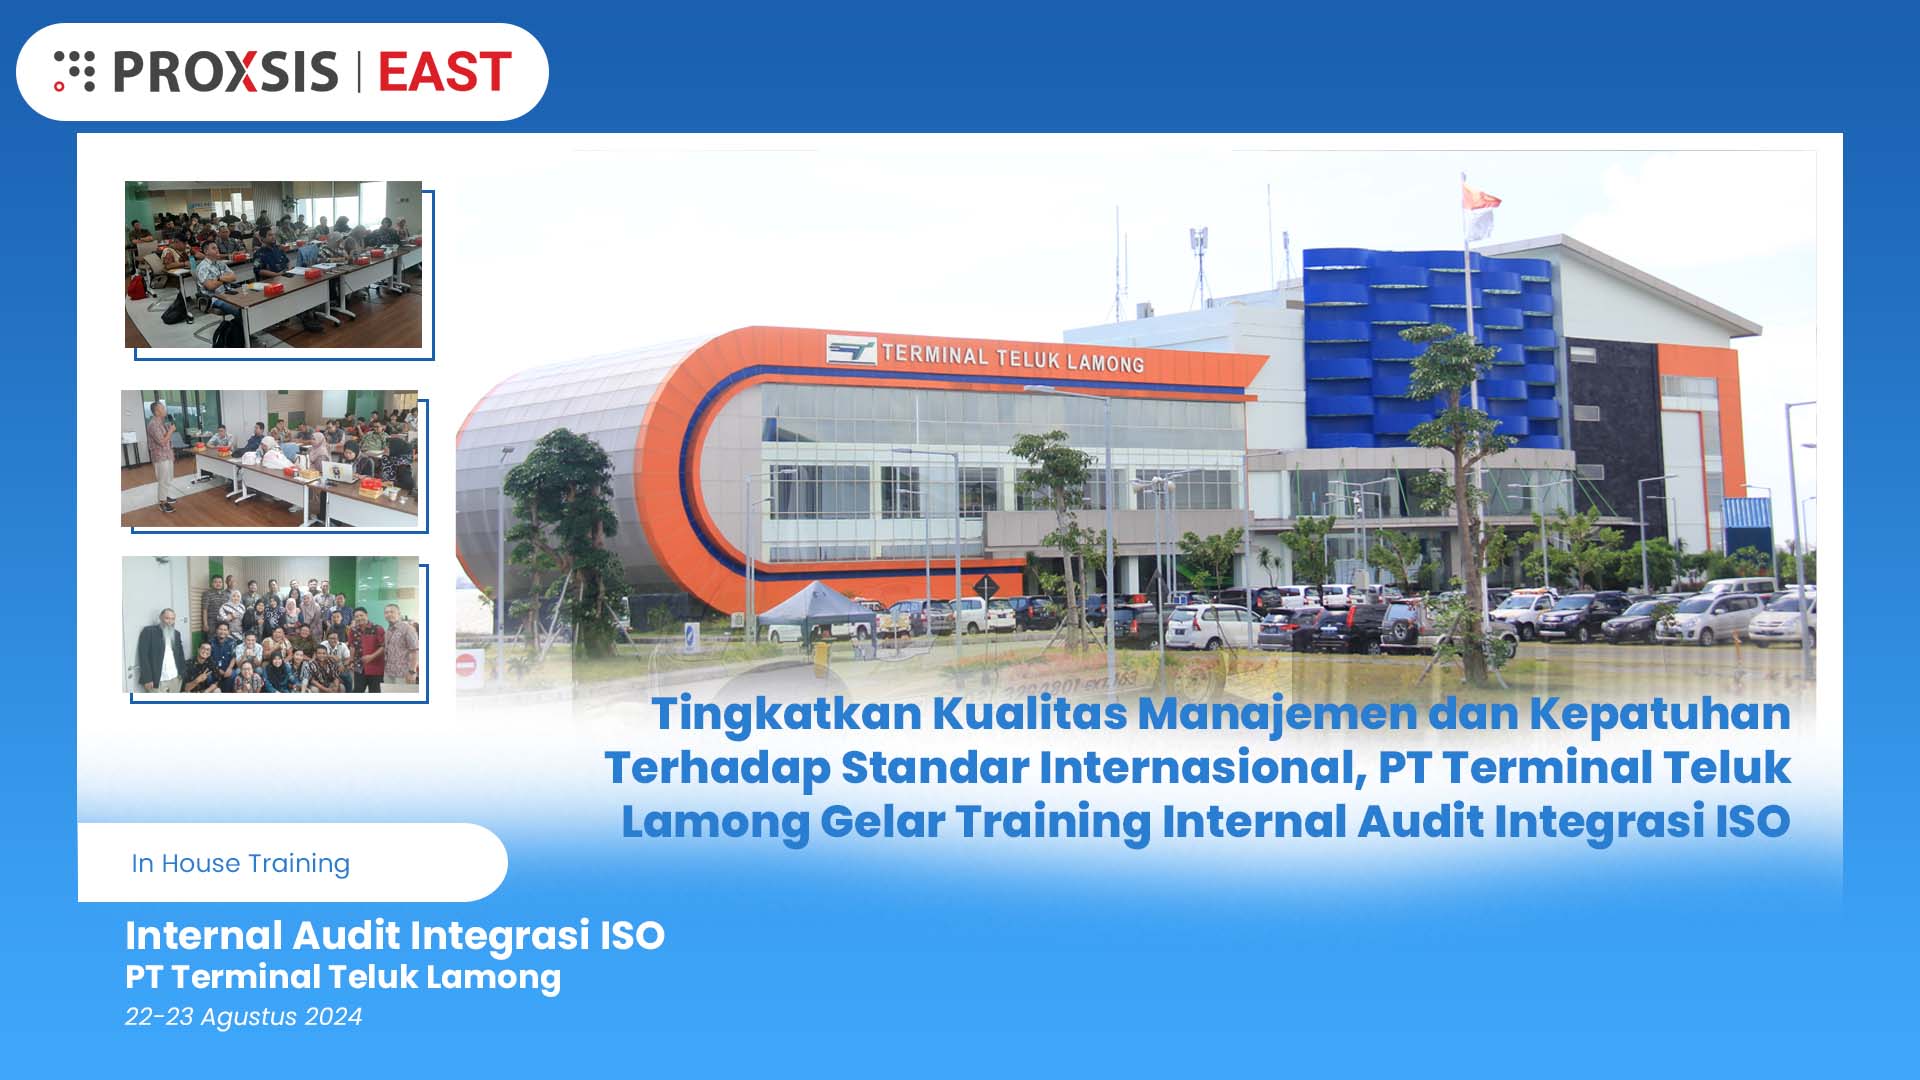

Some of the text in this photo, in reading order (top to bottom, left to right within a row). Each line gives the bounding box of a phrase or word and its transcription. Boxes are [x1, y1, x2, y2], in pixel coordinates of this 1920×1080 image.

[882, 343, 1144, 373] TERMINAL TELUK LAMONG
